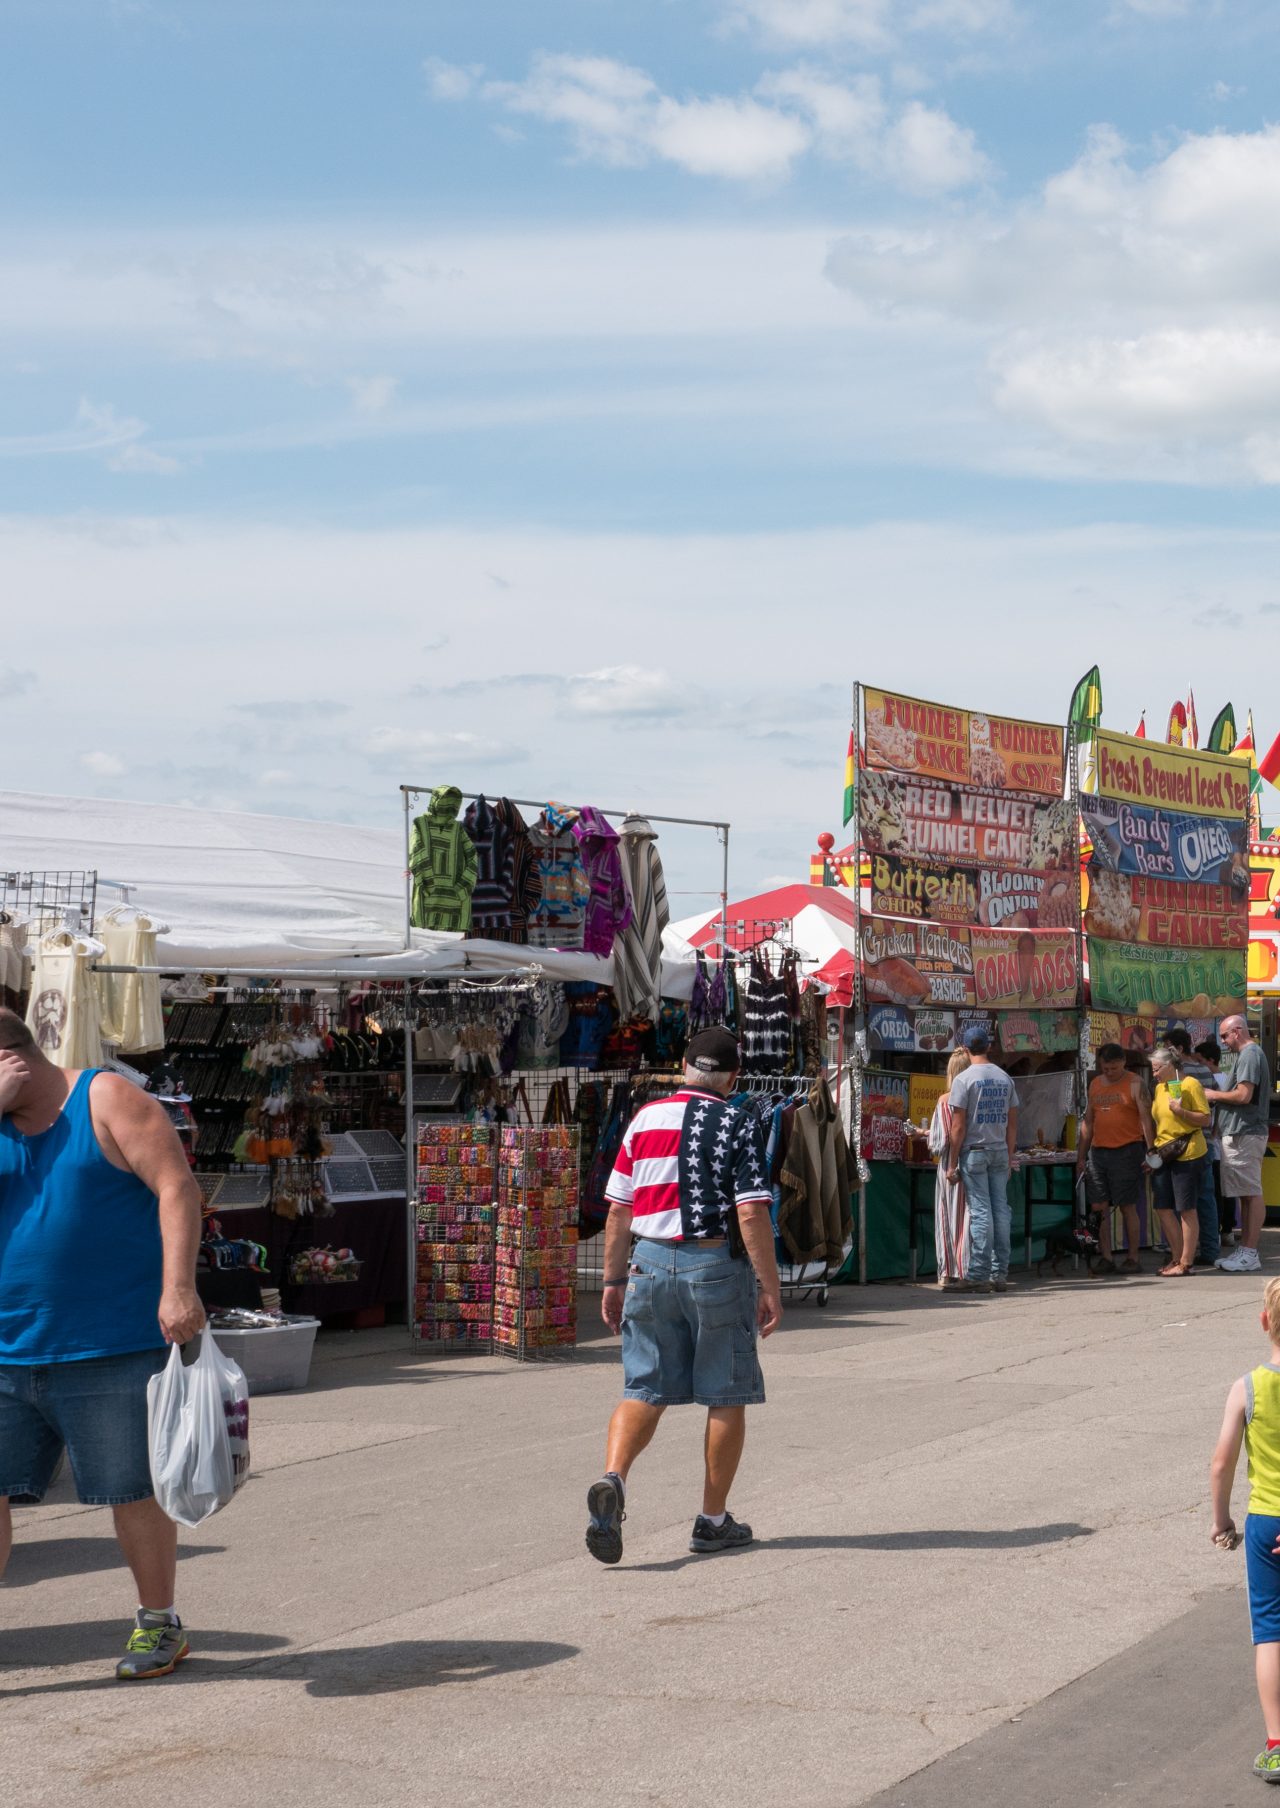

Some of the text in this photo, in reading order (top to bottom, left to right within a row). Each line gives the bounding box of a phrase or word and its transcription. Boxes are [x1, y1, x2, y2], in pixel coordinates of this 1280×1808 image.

[883, 696, 967, 743] FUNNEL
[914, 738, 968, 776] CAKE
[1101, 746, 1141, 796] Fresh
[1142, 756, 1192, 805] Brewed
[1194, 767, 1225, 809] Iced
[889, 774, 1051, 804] FRESH HOMEMADE
[905, 786, 1035, 830] RED VELVET
[906, 819, 1033, 863] FUNNEL CAKE
[1118, 803, 1170, 851] Candy
[1133, 843, 1174, 875] Bars
[873, 855, 978, 913] Butterfly
[1131, 877, 1238, 915] FUNNEL
[877, 895, 923, 917] CHIPS
[987, 895, 1039, 927] ONION
[862, 924, 974, 974] Chicken Tenders
[1147, 909, 1249, 949] CAKES
[976, 950, 1022, 1003] CORN
[1030, 943, 1076, 1003] DOGS
[881, 1020, 911, 1039] OREO
[977, 1113, 1007, 1124] BOOTS
